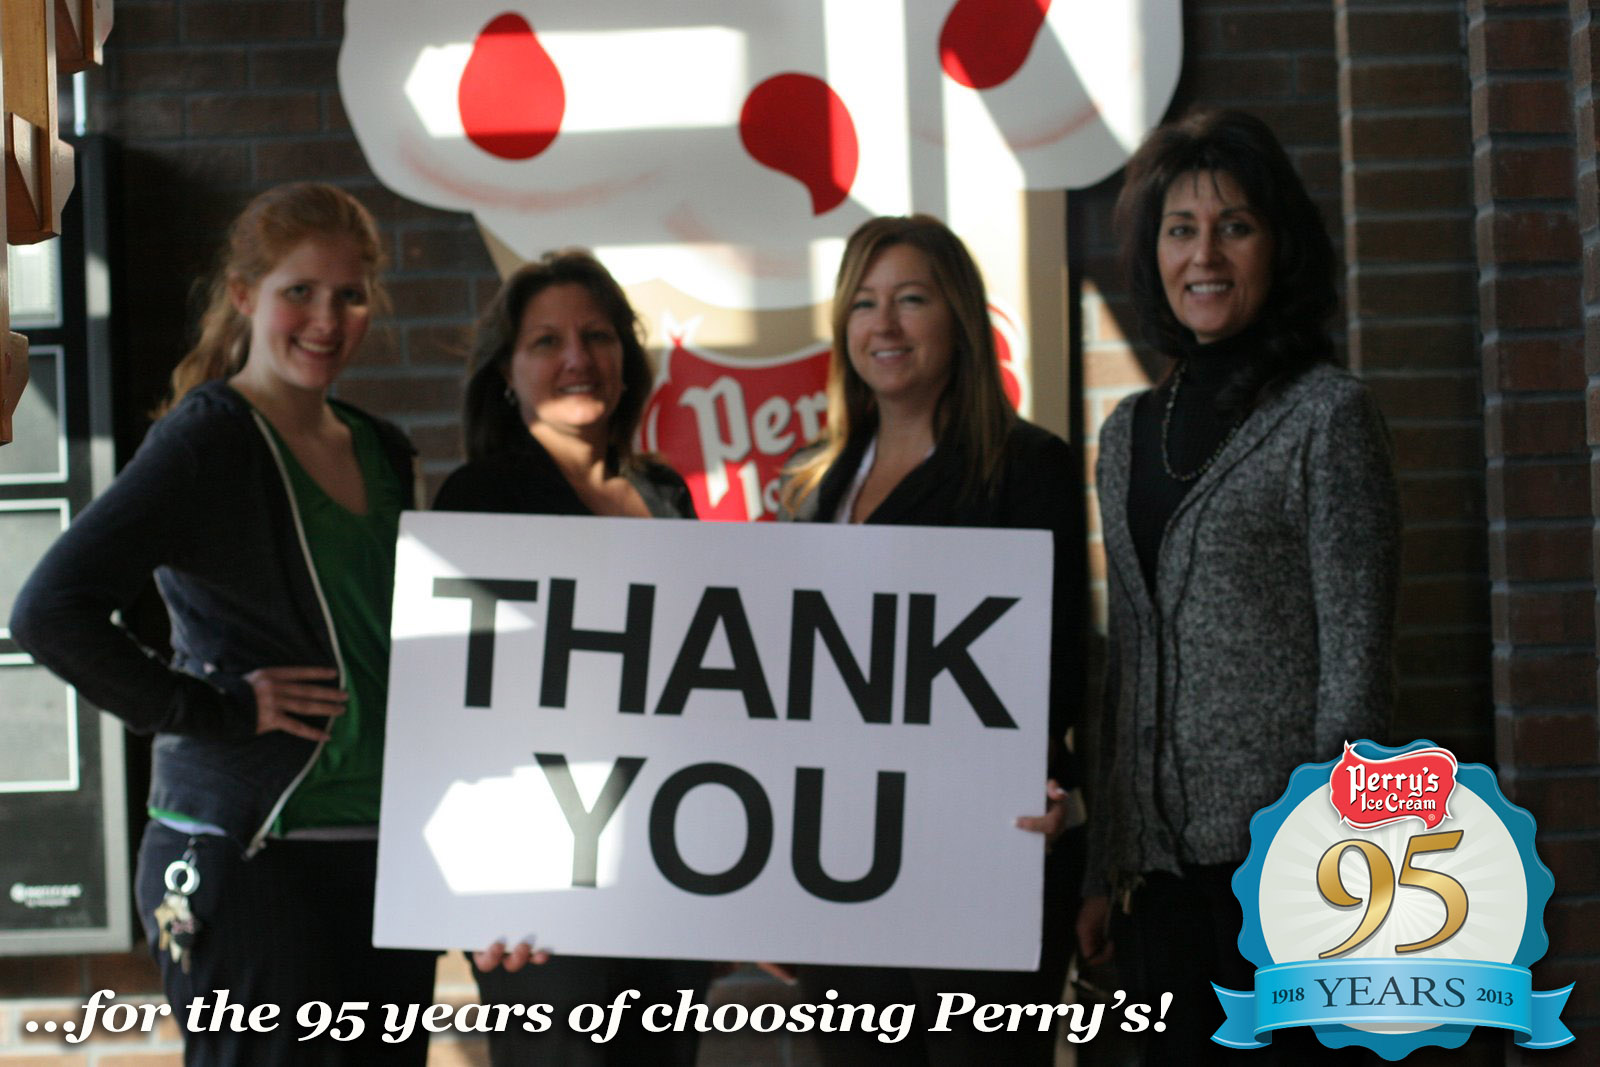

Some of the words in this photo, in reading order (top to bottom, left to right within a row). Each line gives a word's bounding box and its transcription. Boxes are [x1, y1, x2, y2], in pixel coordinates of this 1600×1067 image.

[678, 375, 828, 508] Per
[432, 576, 1022, 730] THANK
[533, 752, 907, 904] YOU
